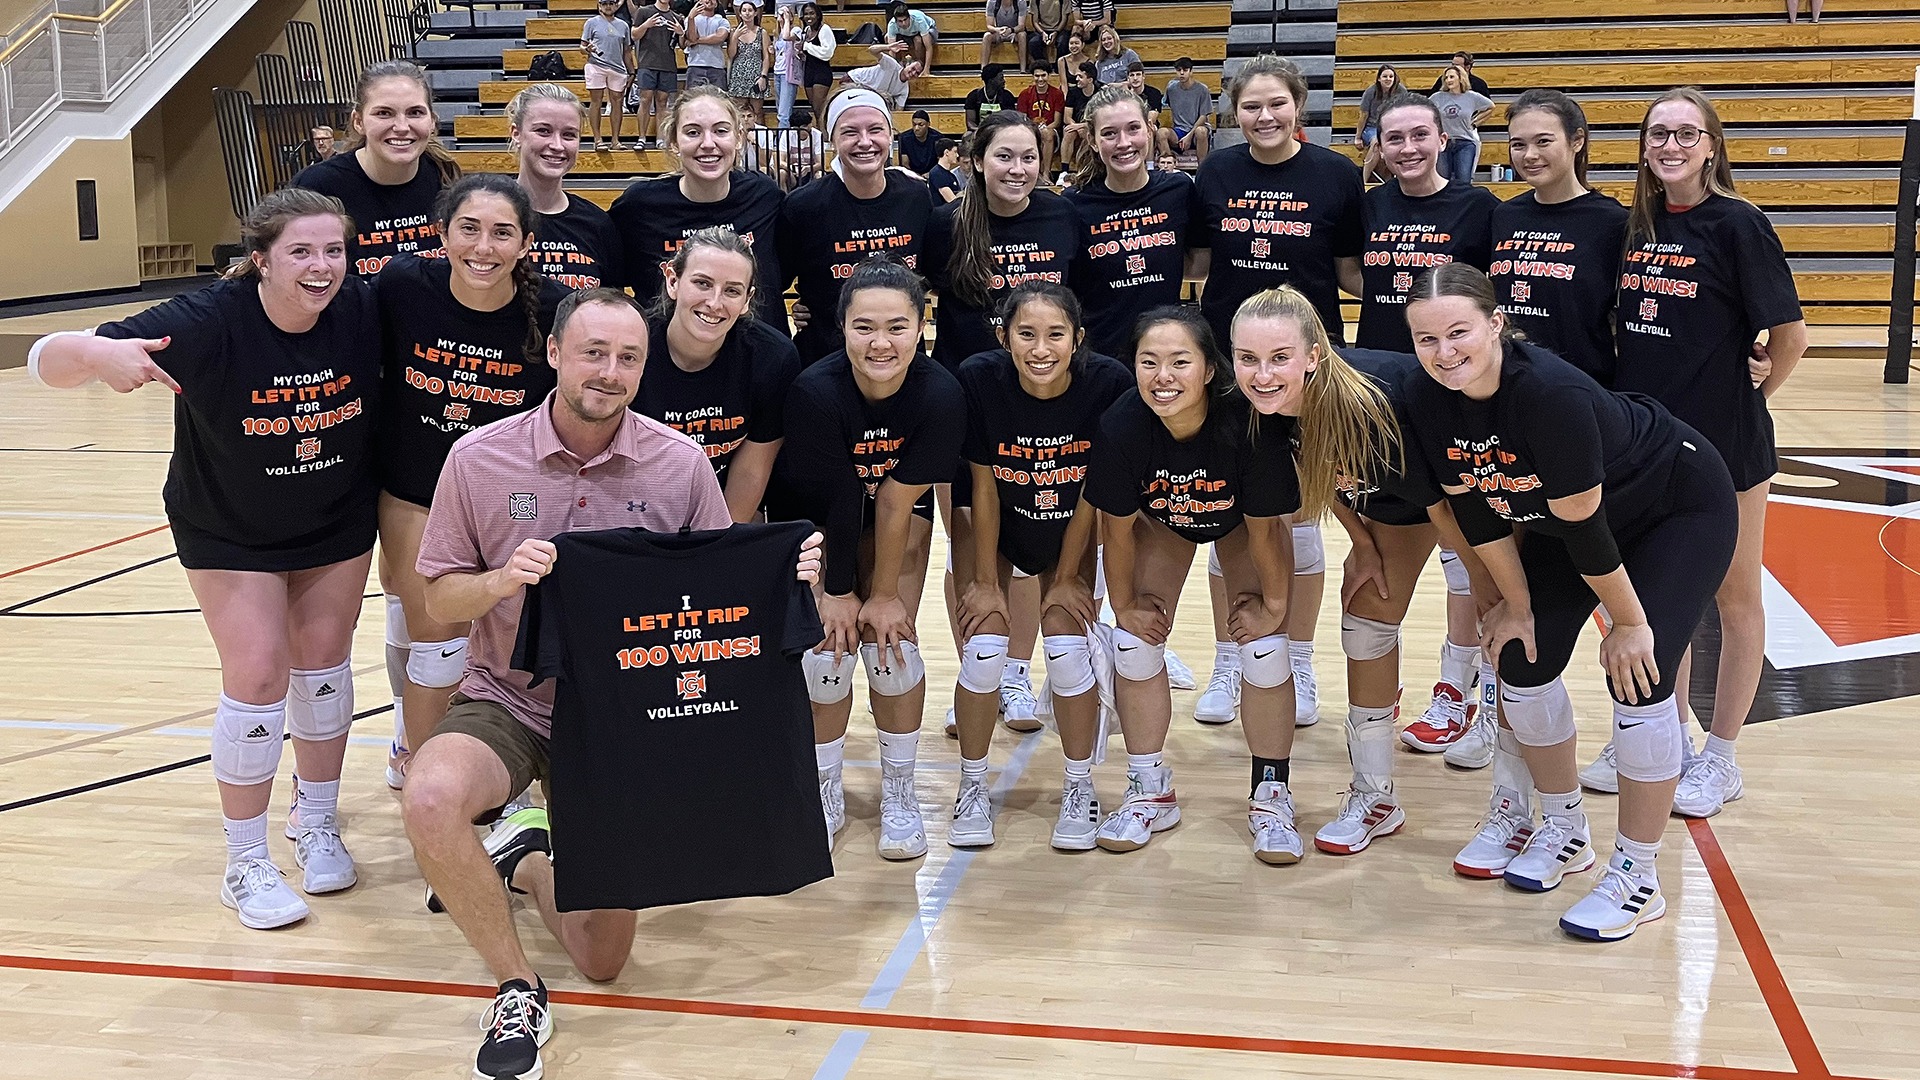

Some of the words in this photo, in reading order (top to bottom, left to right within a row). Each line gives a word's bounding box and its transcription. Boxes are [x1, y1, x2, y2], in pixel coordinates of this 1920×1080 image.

[1245, 190, 1259, 198] MY
[1261, 191, 1293, 199] COACH
[1228, 198, 1258, 209] LET
[1260, 200, 1277, 210] IT
[1280, 201, 1308, 211] RIP
[1121, 207, 1151, 218] COACH
[1256, 211, 1274, 219] FOR
[375, 220, 391, 230] MY
[394, 215, 427, 228] COACH
[1090, 221, 1121, 235] LET
[1124, 218, 1139, 229] IT
[1142, 213, 1168, 225] RIP
[1221, 217, 1250, 232] 100
[1252, 219, 1311, 237] WINS!
[1403, 224, 1436, 232] COACH
[358, 231, 394, 245] LET
[398, 228, 415, 241] IT
[418, 223, 440, 237] RI
[851, 230, 864, 238] MY
[867, 226, 897, 237] COACH
[1122, 229, 1139, 238] FOR
[1370, 232, 1400, 241] LET
[1402, 233, 1419, 242] IT
[1421, 233, 1451, 243] RIP
[1513, 231, 1527, 239] MY
[1528, 232, 1561, 240] COACH
[397, 242, 418, 252] FOR
[542, 242, 578, 251] COACH
[835, 240, 867, 252] LET
[869, 238, 885, 249] IT
[888, 234, 912, 247] RIP
[1005, 243, 1038, 252] COACH
[1088, 241, 1120, 260] 100
[1120, 231, 1176, 251] WINS!
[1396, 243, 1415, 251] FOR
[1495, 240, 1524, 251] LET
[1525, 241, 1543, 251] IT
[1544, 242, 1575, 252] RIP
[1643, 243, 1658, 251] MY
[1657, 244, 1683, 253] COACH
[545, 252, 563, 262] IT
[1009, 253, 1025, 263] IT
[1029, 251, 1055, 262] RIP
[1626, 250, 1653, 262] LET
[1652, 254, 1668, 266] IT
[1669, 255, 1696, 267] RIP
[543, 264, 564, 272] FOR
[830, 263, 859, 278] 10
[1232, 259, 1289, 271] VOLLEYBALL
[1514, 260, 1575, 280] WINS!
[1646, 265, 1663, 275] FOR
[1109, 274, 1164, 289] VOLLEYBALL
[1622, 273, 1640, 290] 00
[1642, 275, 1698, 298] WINS!
[1375, 295, 1407, 303] VOLLEY
[1496, 305, 1550, 317] OLLEYBALL
[437, 338, 456, 351] MY
[459, 343, 502, 360] COACH
[414, 343, 456, 365] LET
[459, 356, 482, 370] IT
[485, 360, 522, 376] RIP
[274, 376, 292, 386] MY
[295, 368, 334, 385] COACH
[453, 370, 478, 382] FOR
[406, 366, 444, 394] 100
[447, 380, 525, 406] WINS!
[252, 389, 294, 403] LET
[299, 386, 320, 401] IT
[296, 402, 320, 413] FOR
[665, 411, 682, 421] MY
[686, 407, 722, 420] COACH
[242, 417, 290, 435] 100
[292, 397, 362, 432] WINS!
[687, 420, 706, 433] IT
[710, 416, 744, 431] RIP
[690, 434, 704, 443] OR
[1017, 436, 1032, 446] MY
[1035, 434, 1073, 446] COACH
[1454, 437, 1469, 450] MY
[1472, 435, 1500, 452] COAC
[998, 443, 1034, 459] LET
[1038, 448, 1057, 460] IT
[1061, 441, 1091, 455] RIP
[1474, 449, 1492, 466] IT
[266, 455, 344, 475] VOLLEYBALL
[1035, 460, 1055, 470] FOR
[1473, 464, 1497, 475] FOR
[992, 465, 1030, 485] 100
[1156, 469, 1169, 478] MY
[1171, 469, 1206, 483] COACH
[1149, 479, 1169, 493] ET
[1173, 482, 1191, 495] IT
[1195, 480, 1226, 492] RIP
[1171, 494, 1190, 502] FOR
[682, 595, 691, 610] I
[623, 613, 672, 631] LET
[678, 611, 702, 627] IT
[708, 606, 749, 624] RIP
[674, 629, 702, 641] FOR
[616, 646, 669, 670] 100
[670, 635, 761, 664] WINS!
[647, 700, 739, 720] VOLLEYBALL
